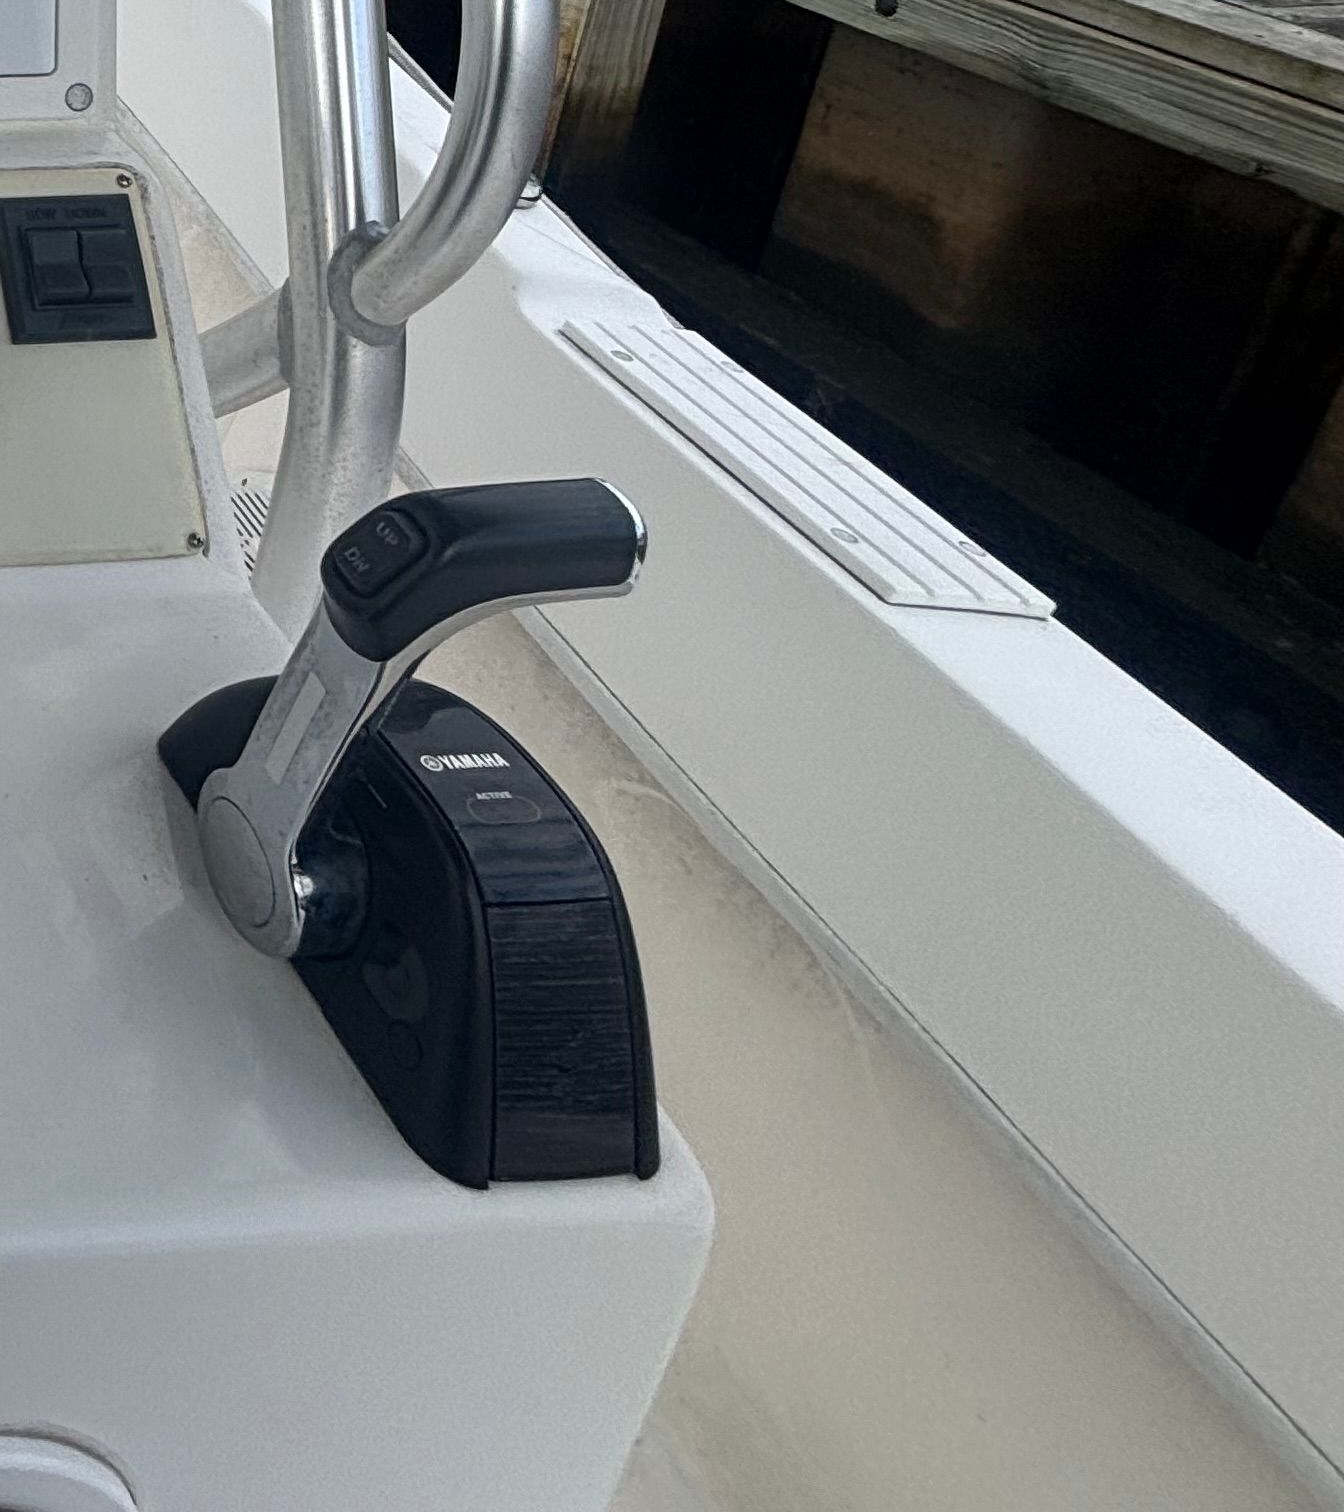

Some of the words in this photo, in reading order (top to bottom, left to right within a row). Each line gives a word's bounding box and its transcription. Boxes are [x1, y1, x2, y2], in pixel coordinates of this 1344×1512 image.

[375, 522, 399, 545] UP
[344, 546, 370, 573] DN
[436, 752, 511, 770] YAMAHA
[475, 791, 513, 801] ACTIVE
